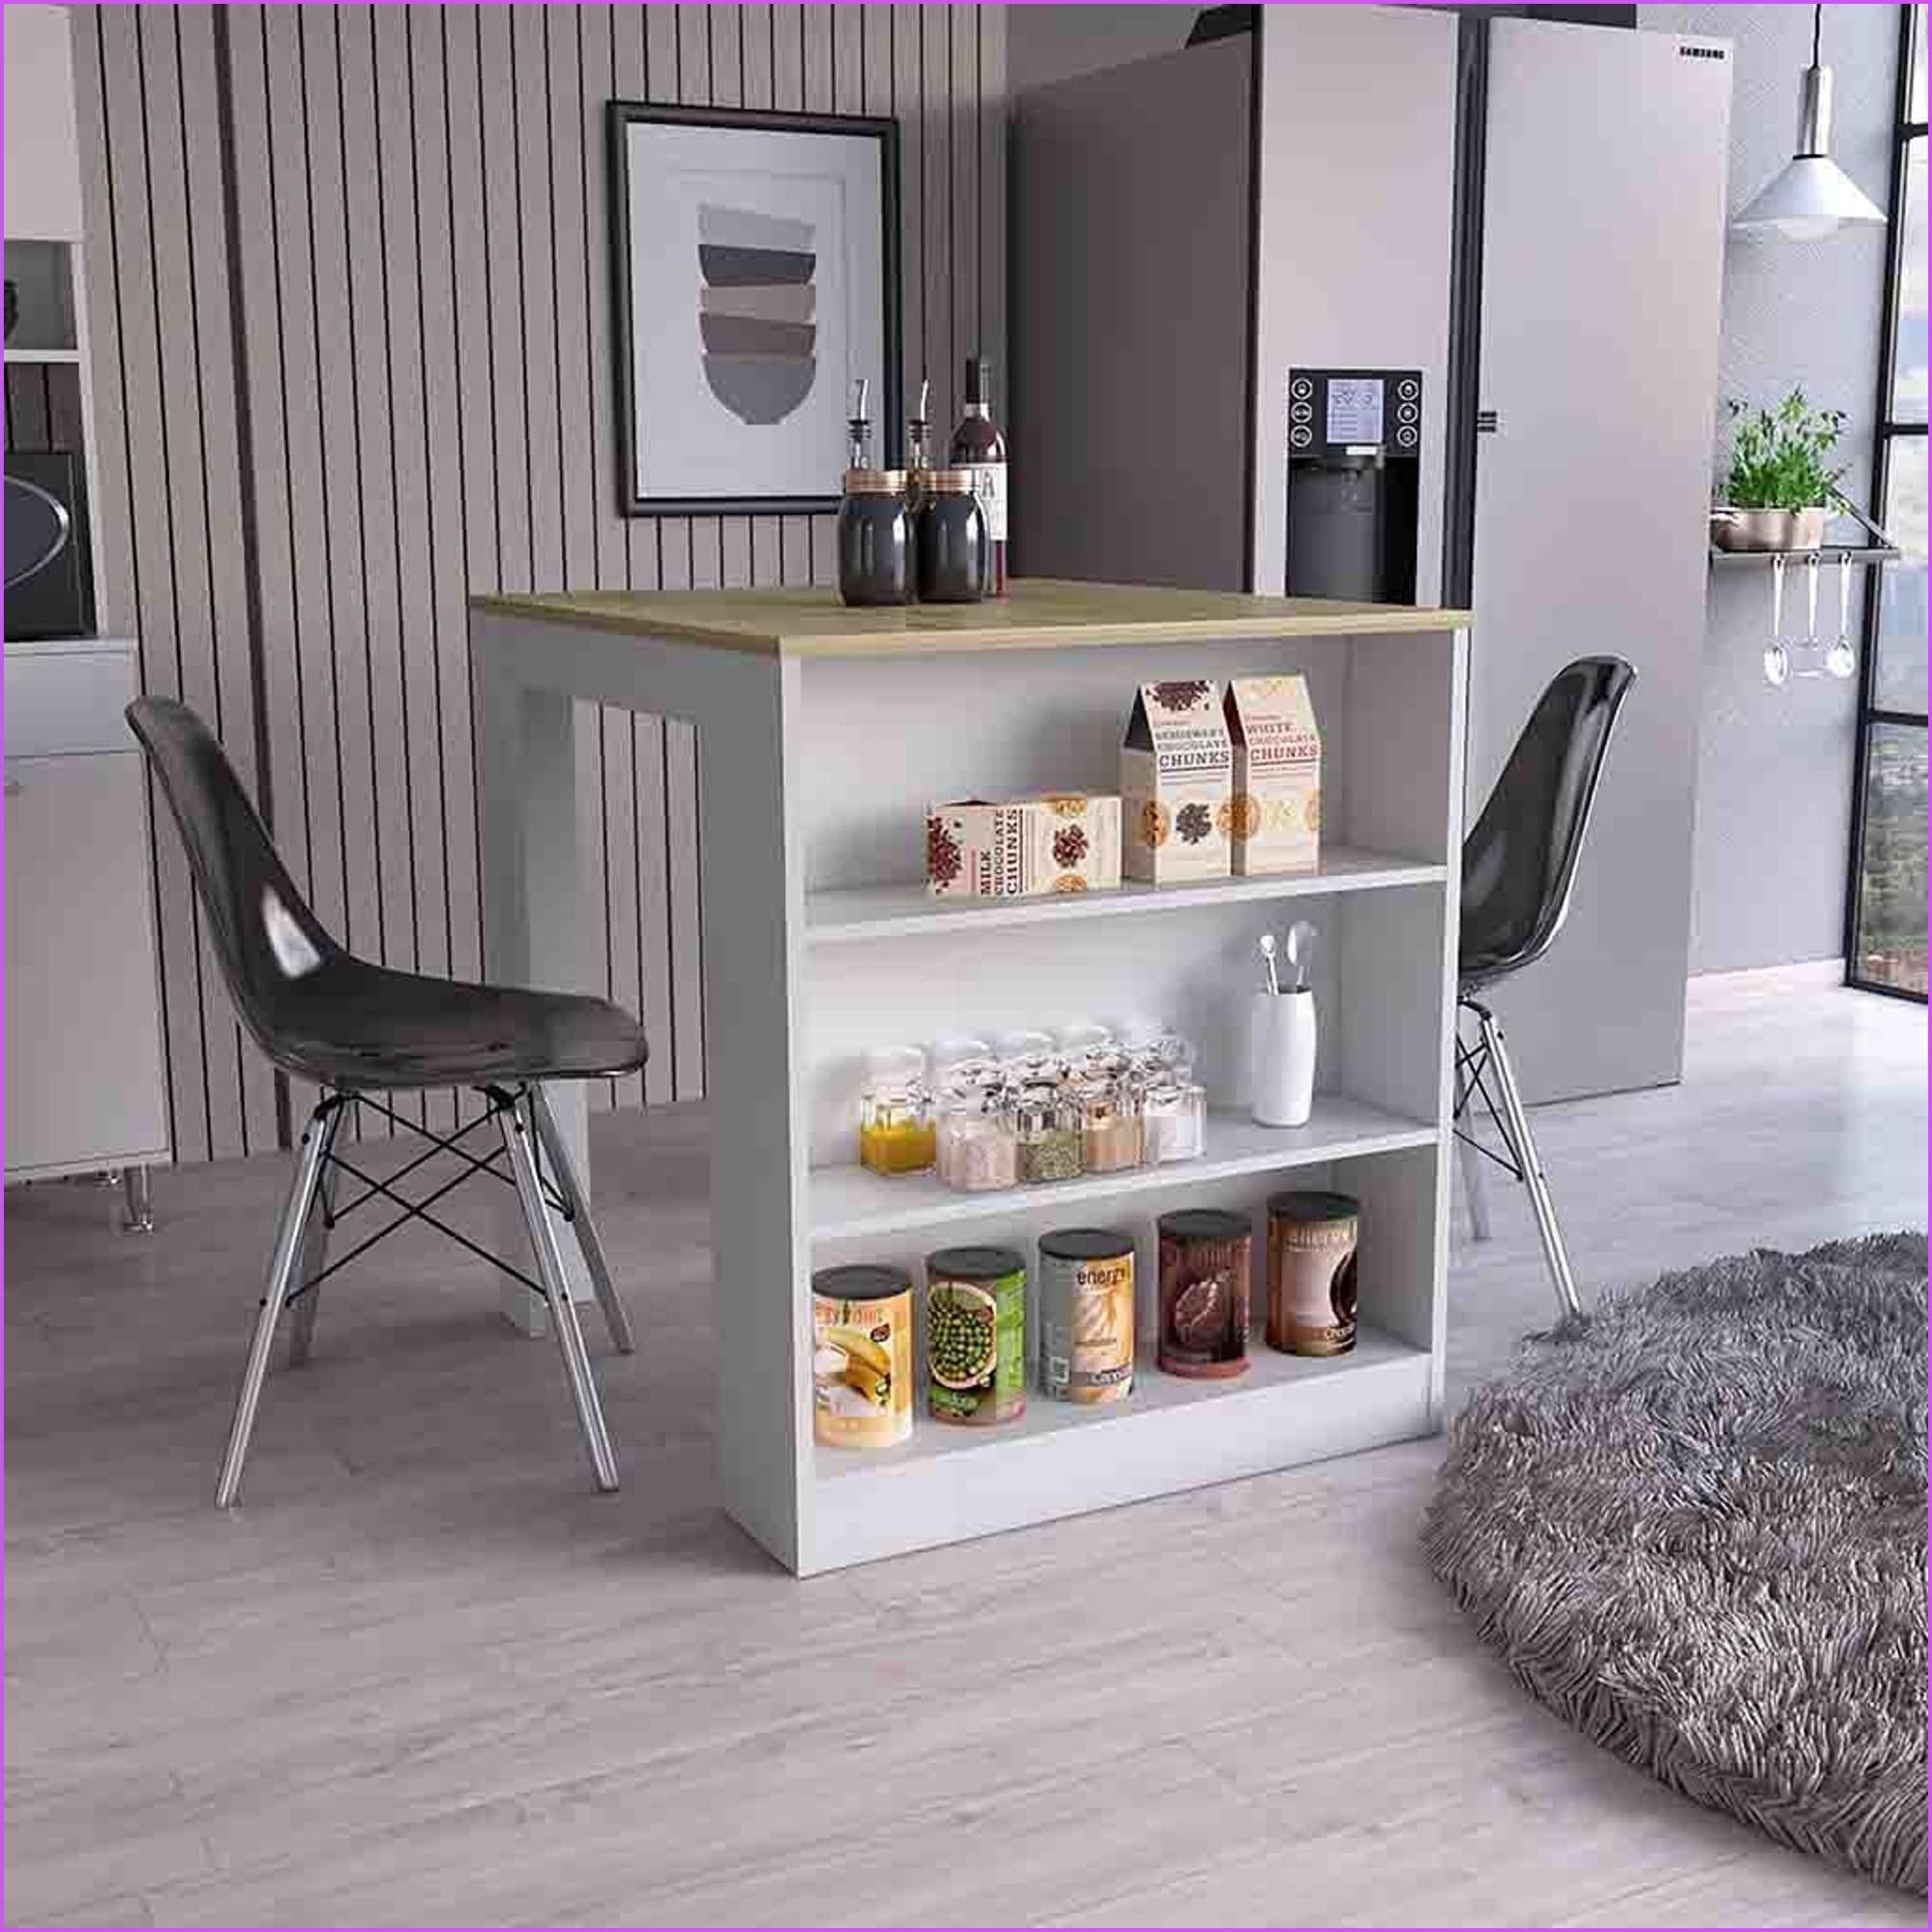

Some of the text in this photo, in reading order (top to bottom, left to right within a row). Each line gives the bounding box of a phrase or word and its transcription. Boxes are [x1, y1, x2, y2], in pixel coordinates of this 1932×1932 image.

[1158, 750, 1231, 768] CHUNKS
[1250, 744, 1318, 761] CHUNKS
[980, 851, 992, 896] MILK
[993, 809, 1004, 896] CHOCOLATE
[1006, 808, 1018, 895] CHUNKS
